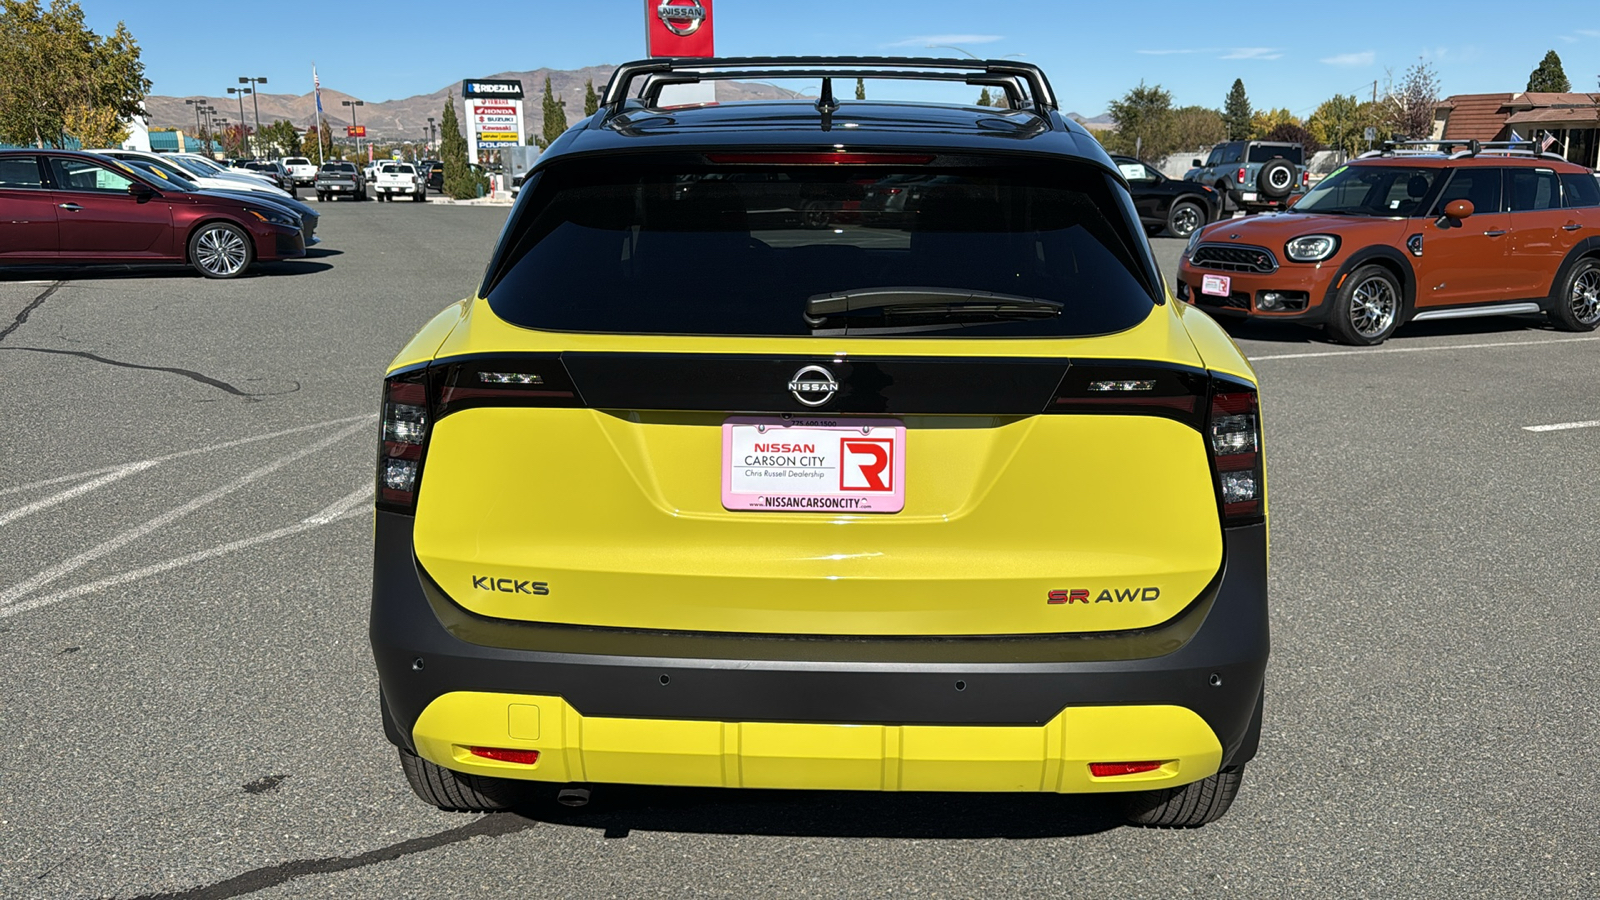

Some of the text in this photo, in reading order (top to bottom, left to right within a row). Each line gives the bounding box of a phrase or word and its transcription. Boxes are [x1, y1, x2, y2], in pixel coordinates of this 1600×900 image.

[662, 8, 702, 16] NISSAN
[480, 84, 520, 93] RIDEZILLA
[788, 383, 838, 391] NISSAN
[754, 443, 815, 453] NISSAN
[744, 455, 825, 467] CARSON CITY
[744, 469, 825, 479] Chris Russell Dealership
[472, 575, 550, 596] KICKS
[1047, 587, 1161, 604] SR AWD
